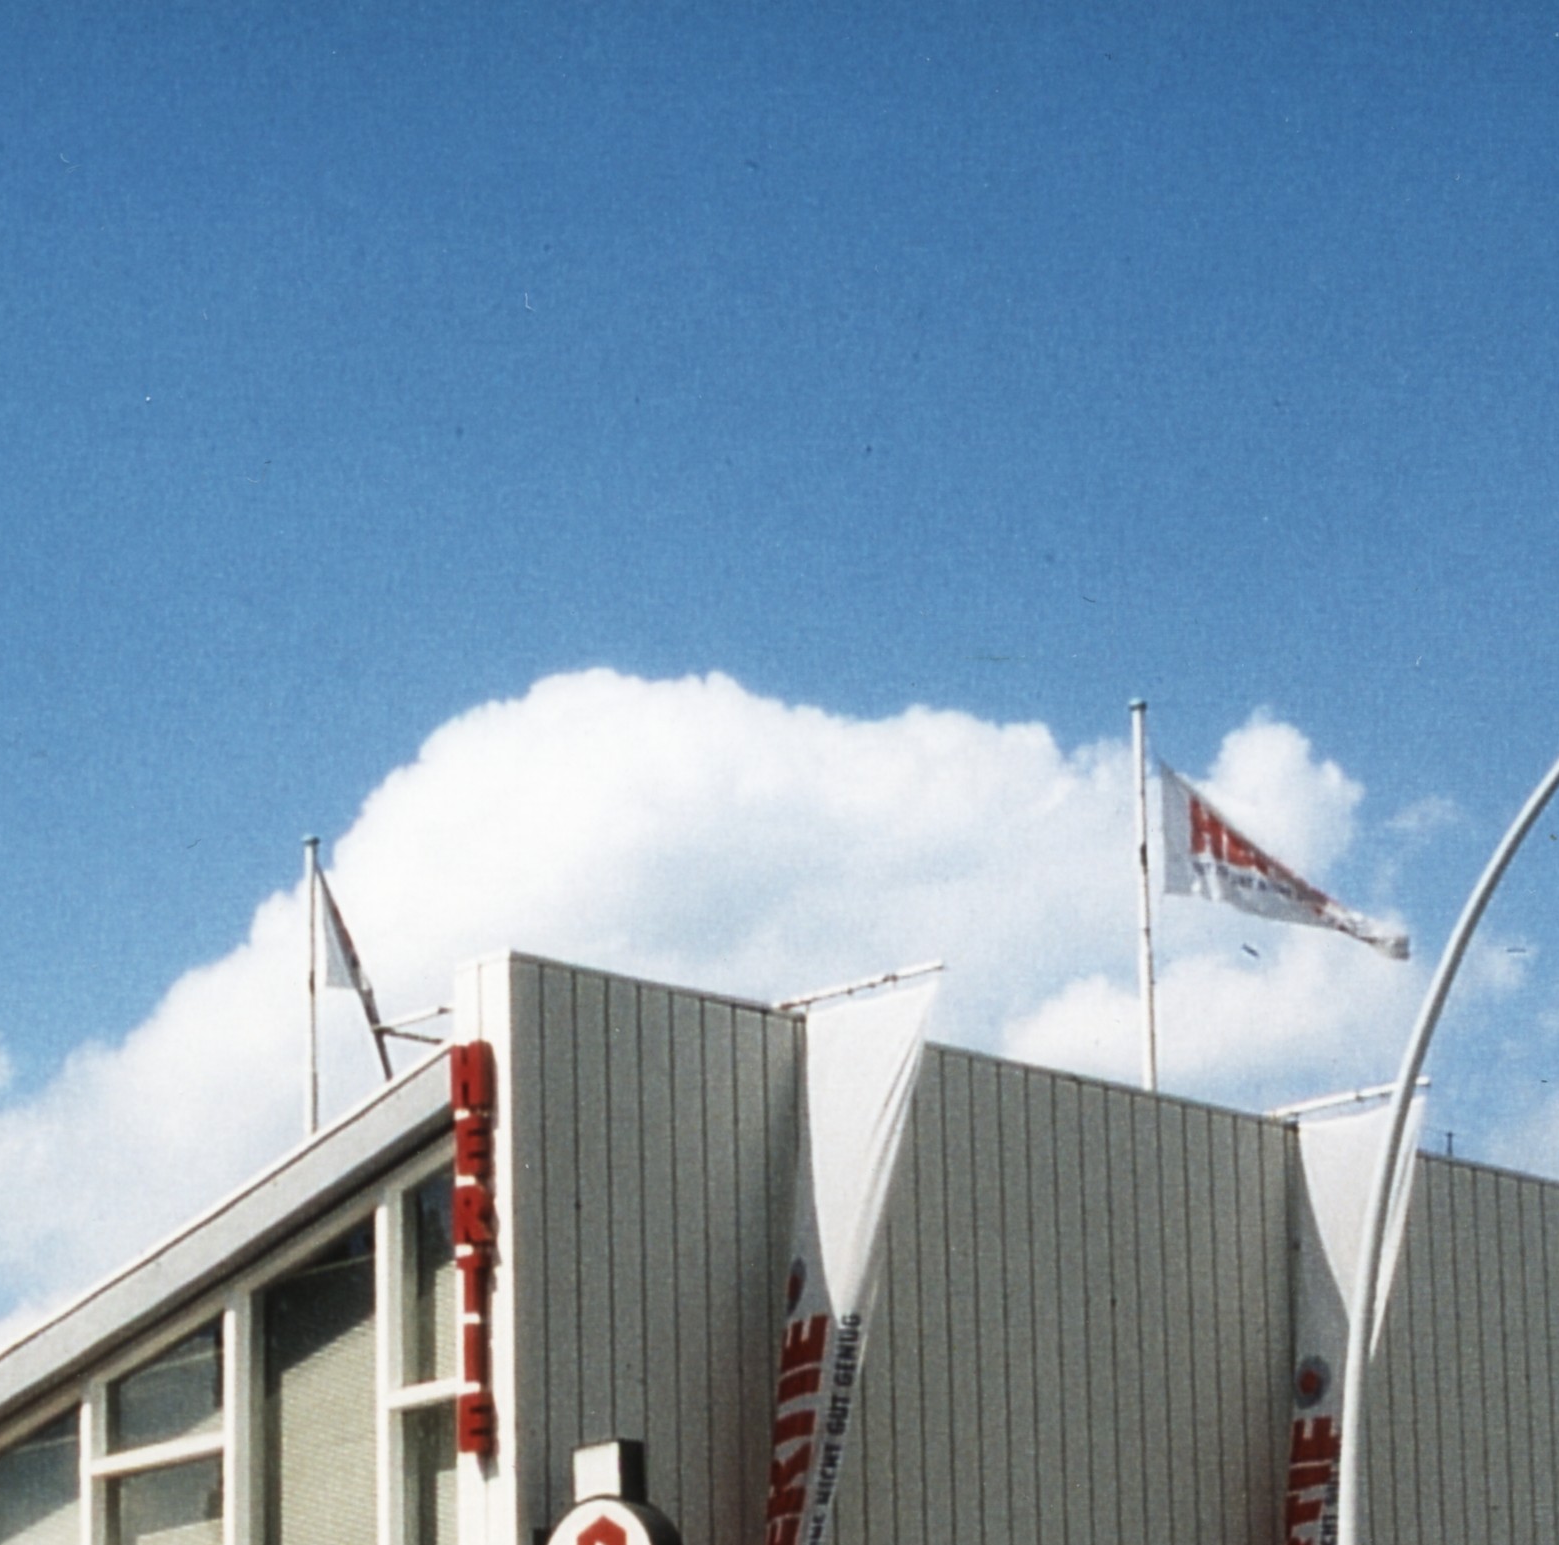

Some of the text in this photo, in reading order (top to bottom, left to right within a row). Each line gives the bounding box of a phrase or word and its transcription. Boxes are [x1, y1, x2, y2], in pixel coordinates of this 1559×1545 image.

[451, 1040, 496, 1453] HERTIE
[834, 1312, 862, 1386] GENUG
[825, 1387, 851, 1435] GUT
